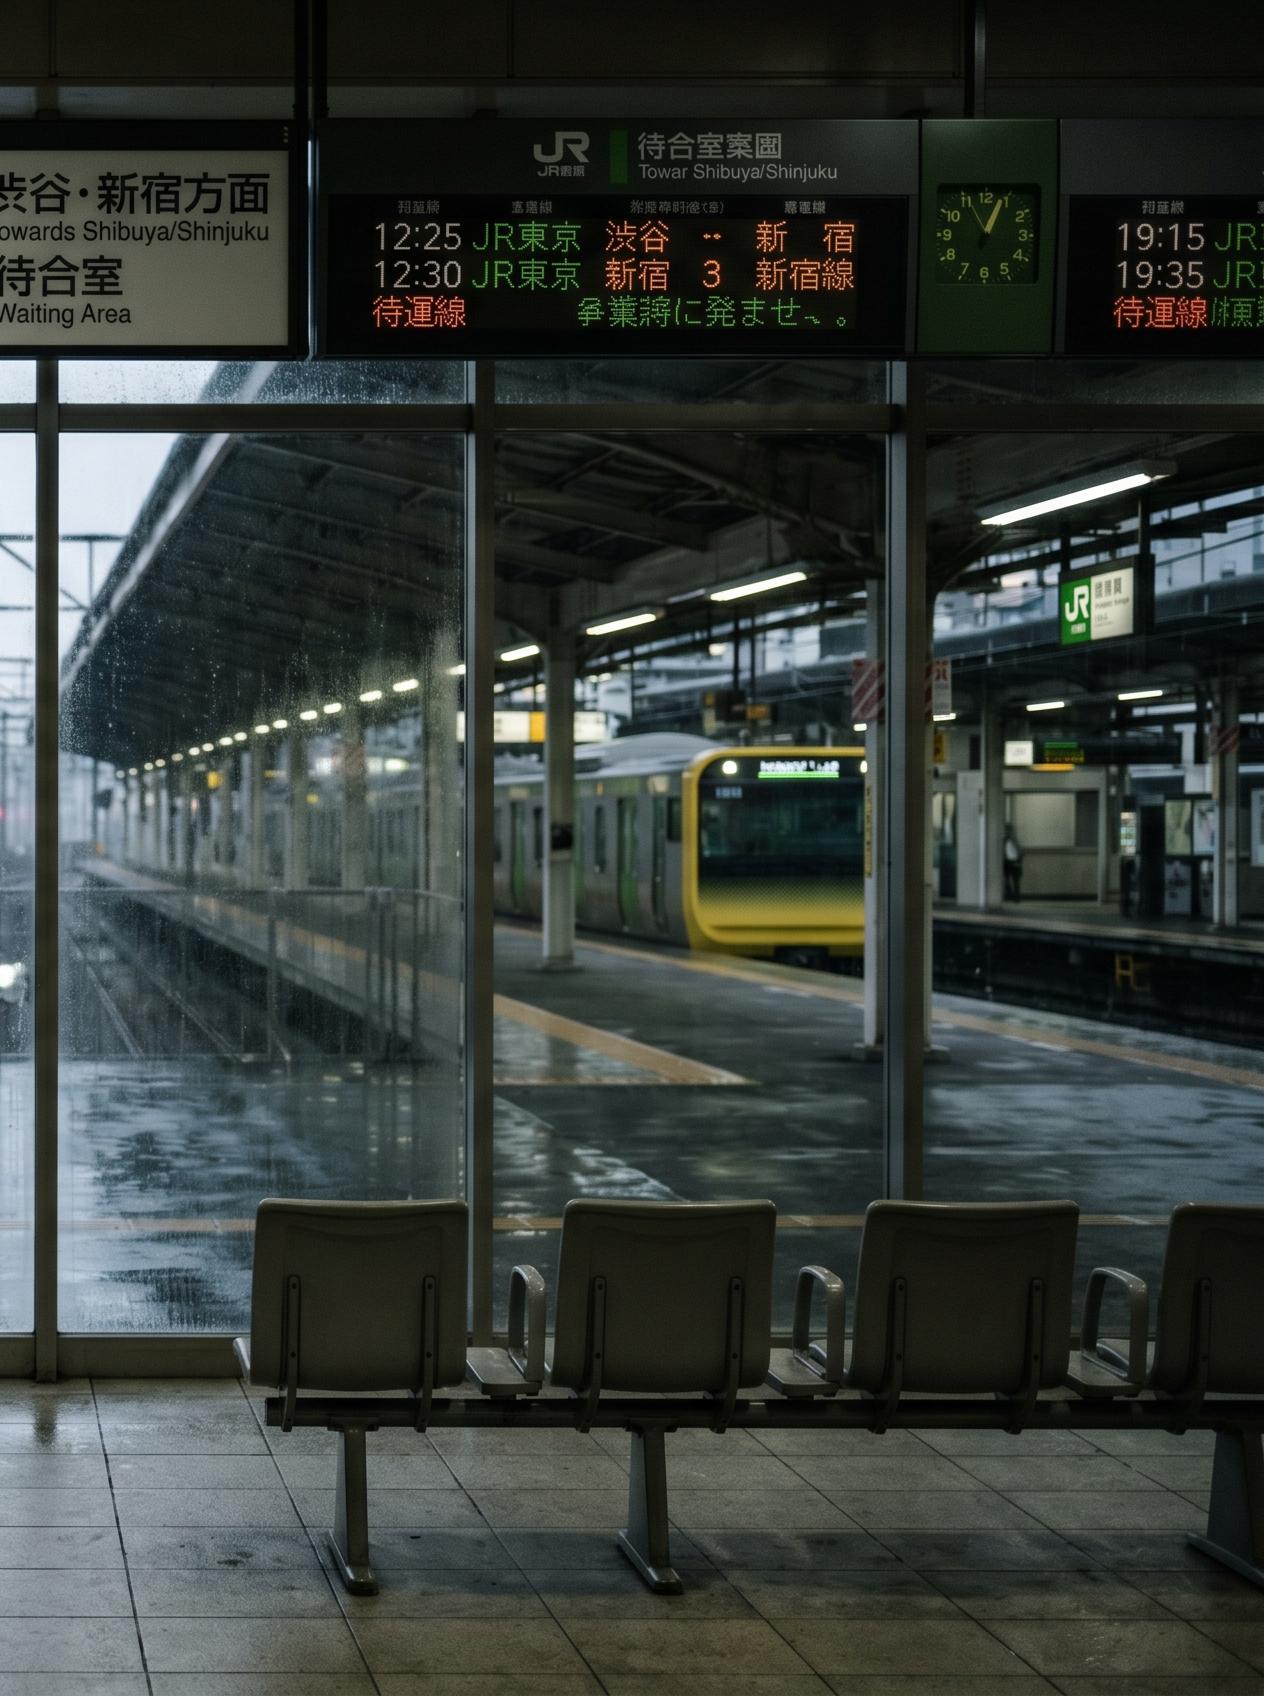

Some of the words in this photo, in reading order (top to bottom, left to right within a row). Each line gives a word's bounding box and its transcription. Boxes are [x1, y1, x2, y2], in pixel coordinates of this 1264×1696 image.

[534, 132, 589, 163] JR
[639, 164, 688, 179] Towar
[694, 164, 837, 182] Shibuya/Shinjuku
[980, 192, 993, 203] 12
[947, 210, 960, 222] 10
[1016, 211, 1024, 222] 2
[84, 221, 268, 246] Shibuya/Shinjuku
[376, 223, 461, 250] 12:25
[473, 221, 581, 252] JR東京
[606, 221, 668, 252] 渋谷
[943, 229, 952, 240] 9
[1018, 229, 1028, 241] 3
[1119, 224, 1204, 250] 19:15
[946, 248, 955, 260] 8
[1013, 249, 1023, 261] 4
[376, 261, 461, 288] 12:30
[472, 258, 580, 290] JR東京
[606, 258, 669, 290] 新宿
[703, 260, 720, 287] 3
[756, 258, 853, 290] 新宿線
[961, 263, 970, 275] 7
[980, 267, 989, 278] 6
[1000, 263, 1008, 274] 5
[1118, 261, 1203, 288] 19:35
[81, 303, 131, 323] Area
[373, 296, 465, 327] 待運線
[1114, 296, 1206, 327] 待運線
[1065, 585, 1090, 622] JR
